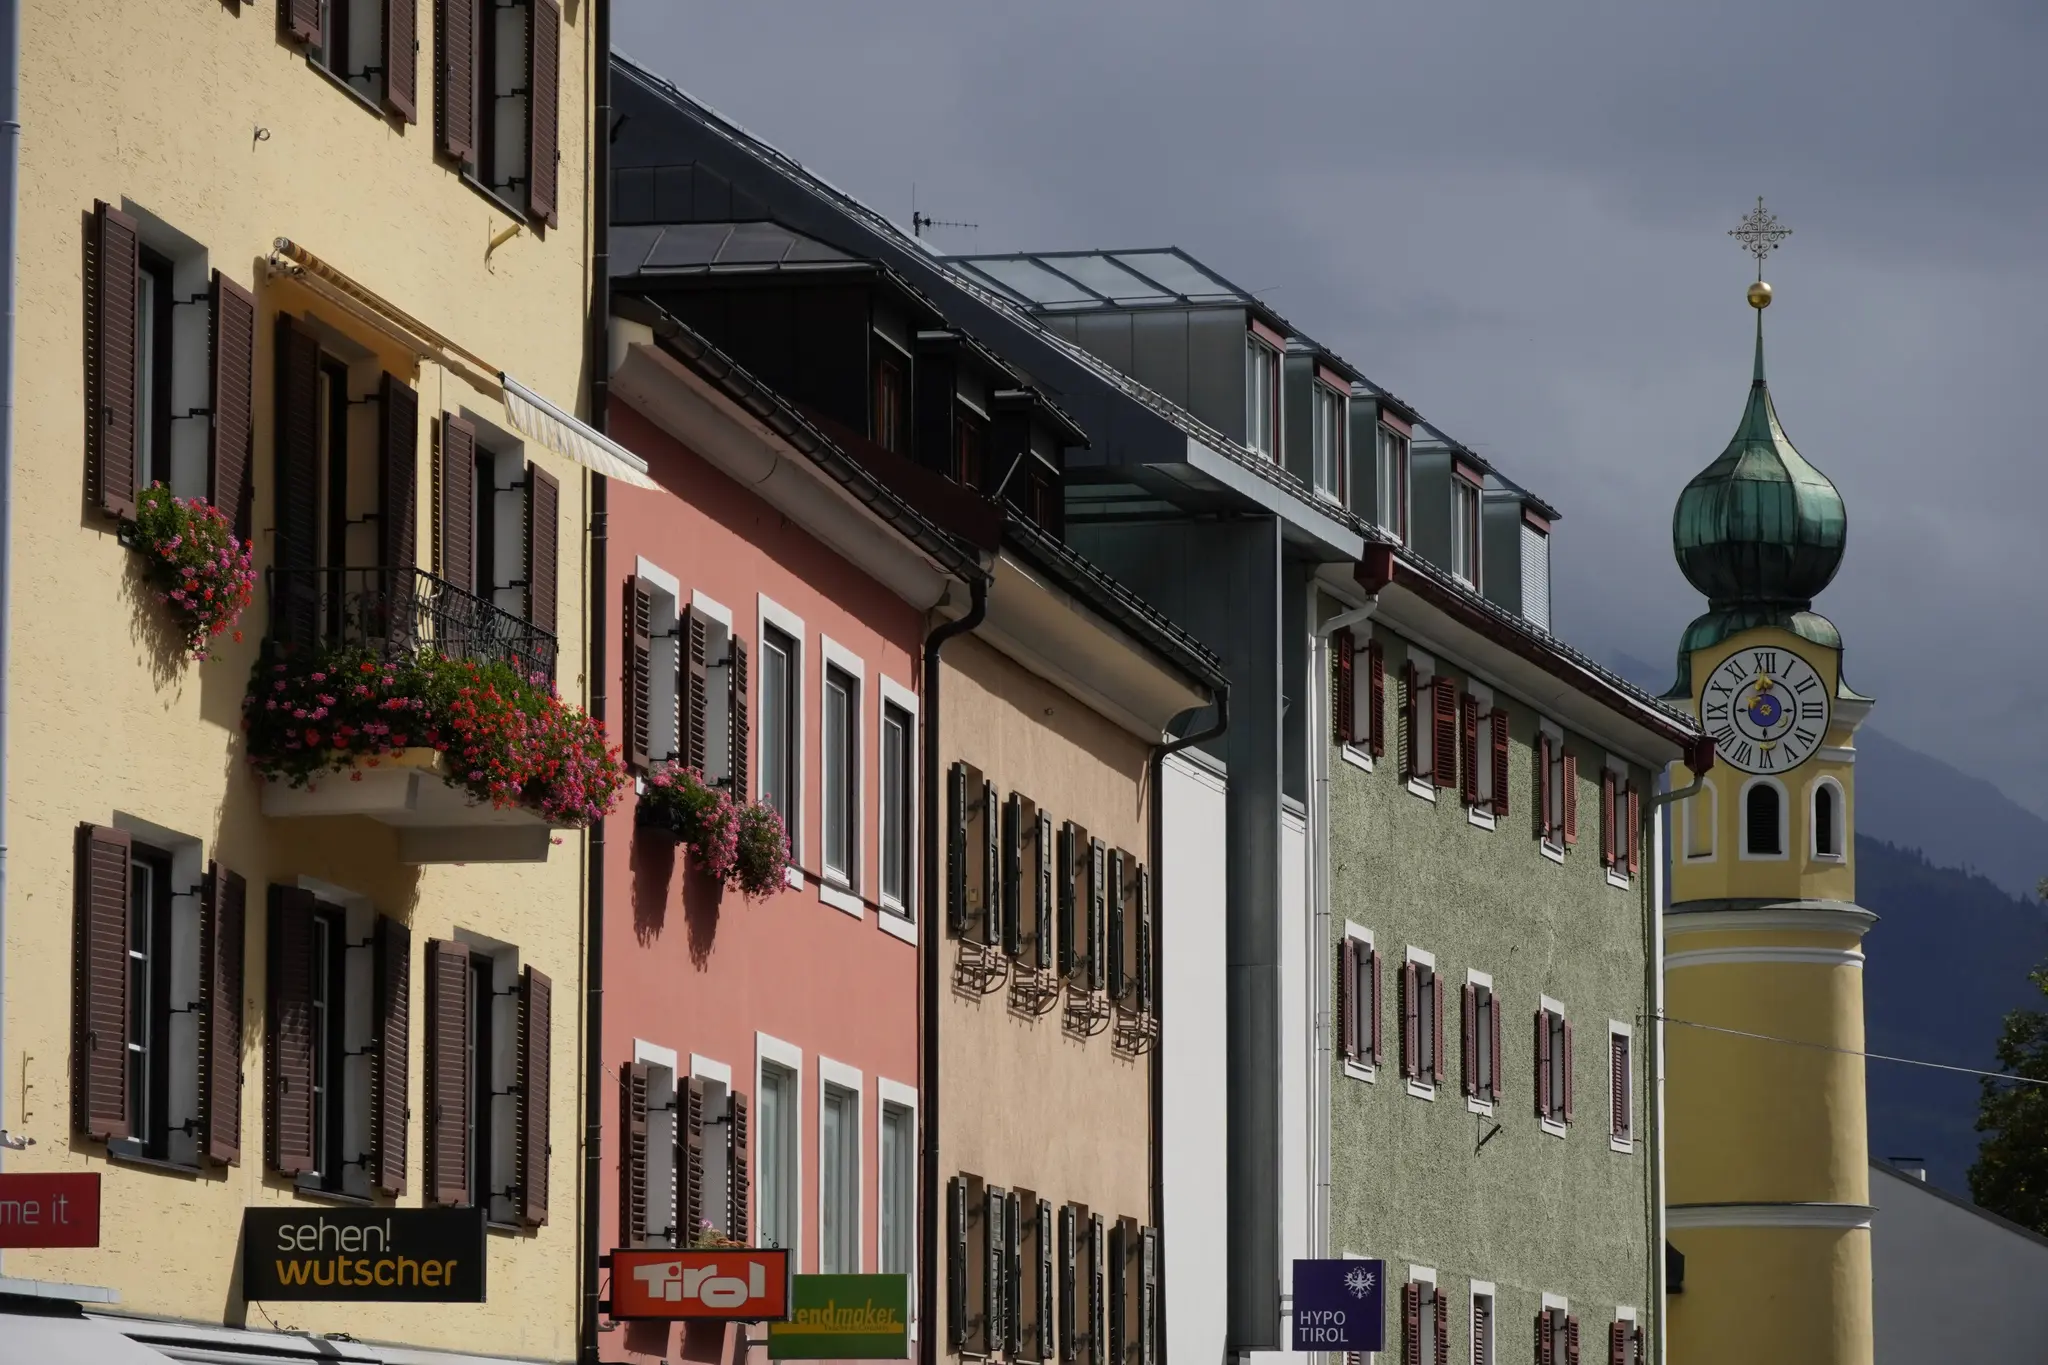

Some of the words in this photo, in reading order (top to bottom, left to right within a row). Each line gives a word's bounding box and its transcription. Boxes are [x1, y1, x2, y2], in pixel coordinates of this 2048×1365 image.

[1724, 660, 1748, 685] XI
[1753, 652, 1776, 673] XII
[1781, 659, 1796, 679] I
[1710, 680, 1733, 699] X
[1794, 675, 1817, 695] II
[1706, 702, 1728, 721] IX
[1801, 701, 1823, 720] III
[1794, 726, 1816, 749] IV
[1731, 741, 1753, 765] VII
[1758, 748, 1774, 768] VI
[1783, 742, 1799, 763] V
[53, 1193, 68, 1224] it
[277, 1216, 391, 1252] sehen!
[275, 1255, 458, 1286] wutscher
[633, 1261, 766, 1308] Tirol
[1300, 1310, 1346, 1326] HYPO
[1299, 1327, 1349, 1343] TIROL
